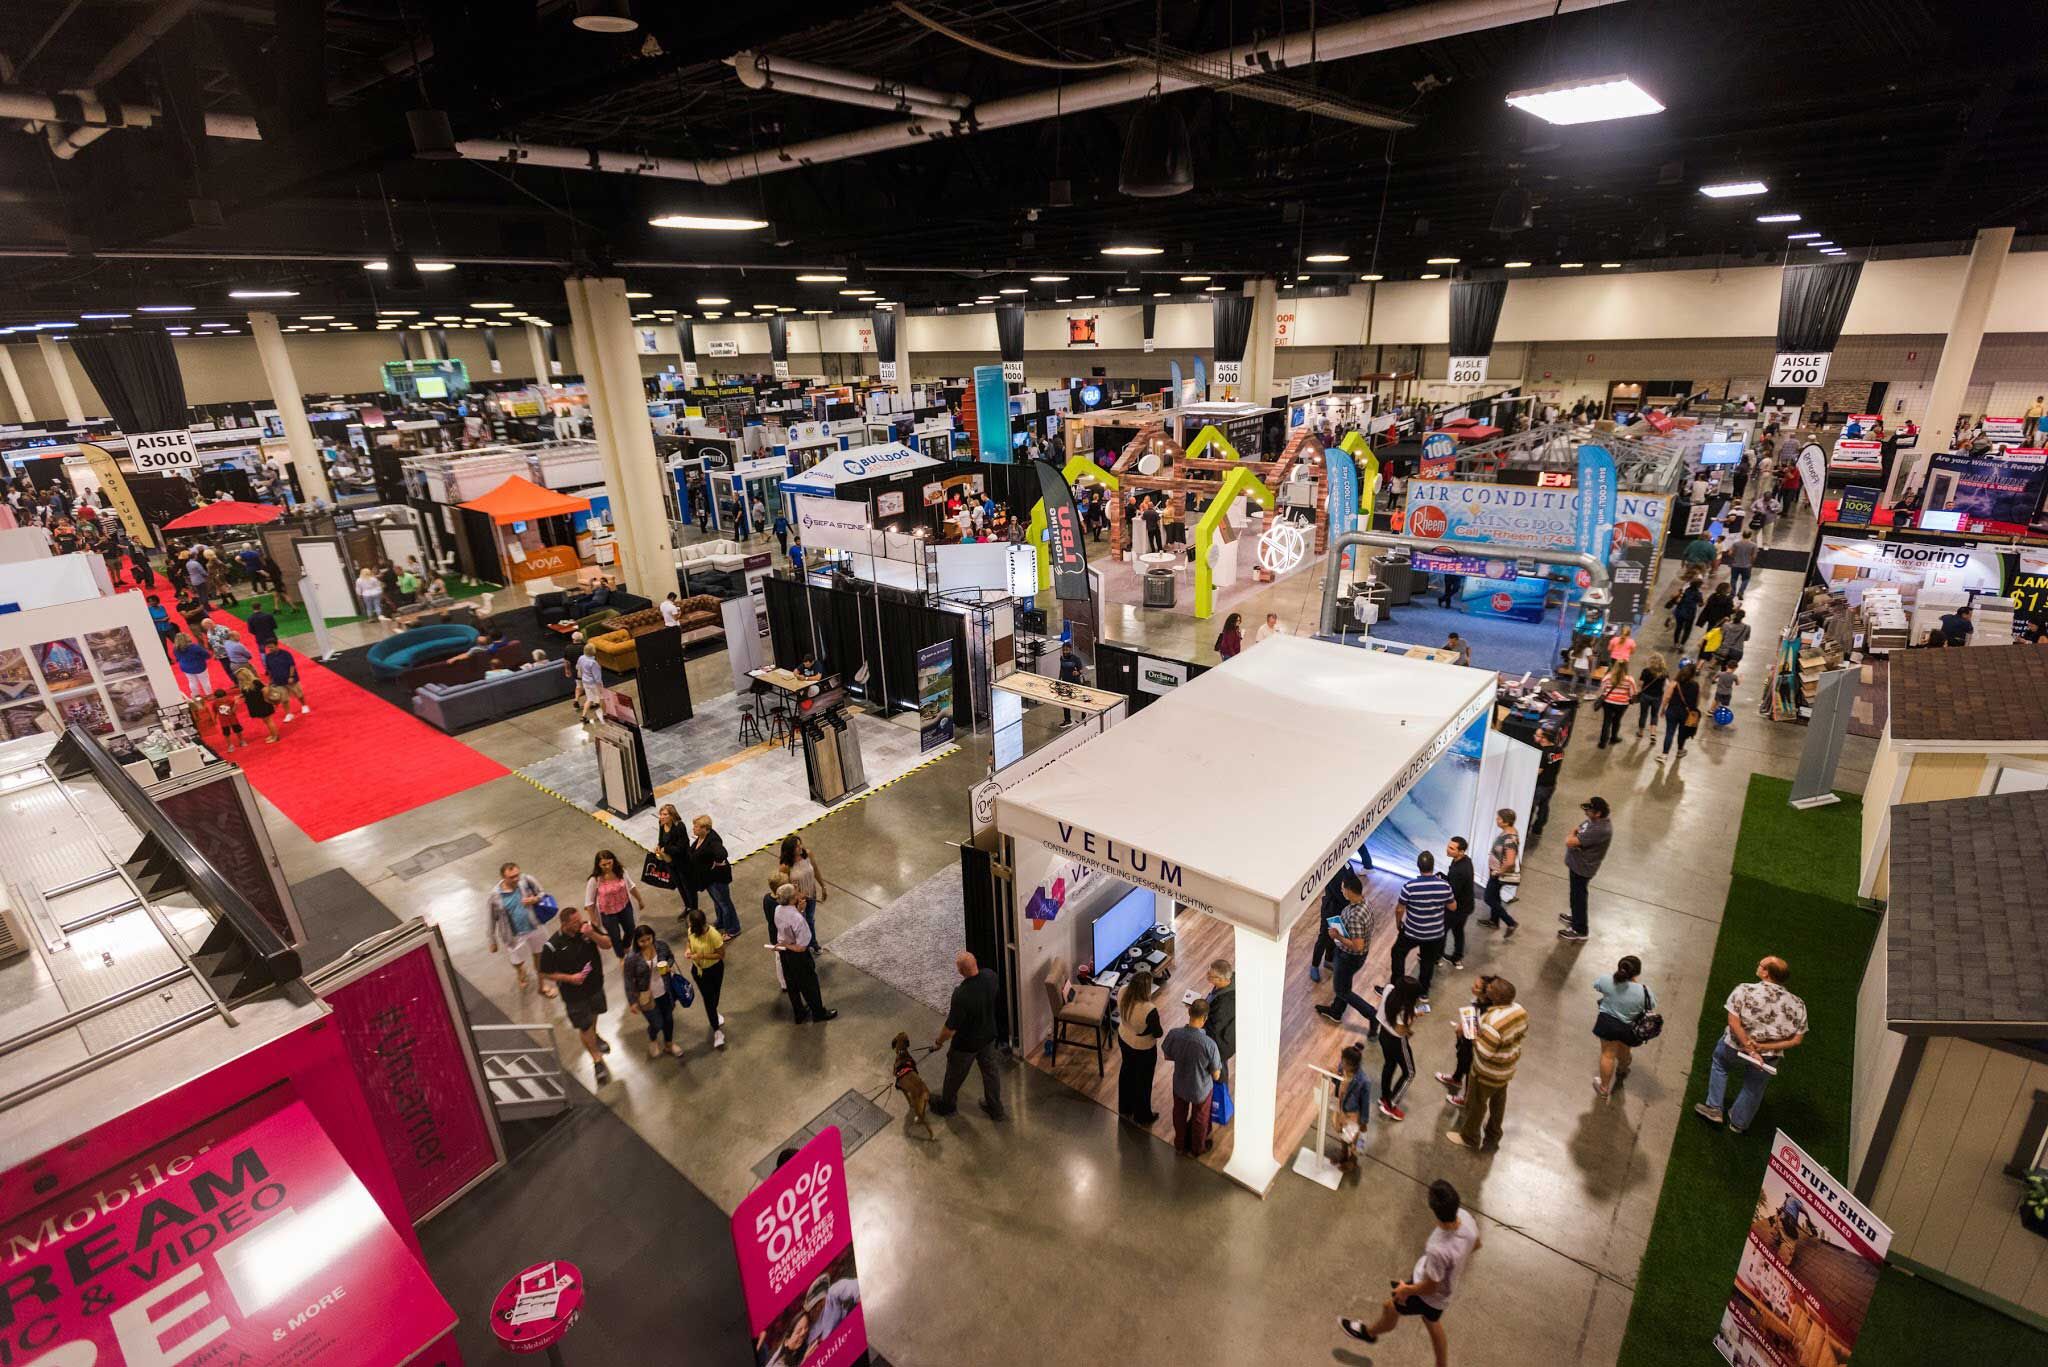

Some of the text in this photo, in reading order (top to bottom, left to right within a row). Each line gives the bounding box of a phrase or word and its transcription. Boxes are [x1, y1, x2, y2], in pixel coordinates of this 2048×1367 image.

[1277, 314, 1294, 322] OOR
[1279, 325, 1286, 334] 3
[1275, 338, 1288, 346] EXIT
[1456, 360, 1482, 368] AISLE
[1782, 357, 1821, 366] AISLE
[882, 370, 895, 378] 1100
[1218, 373, 1238, 383] 900
[1454, 370, 1480, 381] 800
[1780, 369, 1817, 383] 700
[136, 435, 187, 449] AISLE
[140, 450, 192, 468] 3000
[860, 450, 909, 467] BULLDOG
[1972, 460, 2008, 469] Windows
[2010, 463, 2044, 471] Ready?
[104, 472, 118, 492] HOT
[1414, 485, 1449, 501] AIR
[1845, 501, 1872, 512] 100%
[836, 522, 865, 531] STONE
[1413, 506, 1446, 536] Rheem
[1049, 507, 1063, 564] LIGHTING
[1455, 526, 1479, 536] Call
[526, 556, 562, 570] VOYA
[1872, 557, 1952, 569] FACTORY OUTLET
[1881, 543, 1970, 569] Flooring
[2014, 575, 2048, 589] LAM
[1148, 670, 1175, 683] Orchard
[1300, 804, 1377, 902] CONTEMPORARY
[1377, 771, 1408, 814] CEILING
[1409, 740, 1442, 780] DESIGNS
[1449, 697, 1481, 738] LIGHTING
[1058, 821, 1182, 887] VELUM
[1043, 840, 1214, 914] CONTEMPORARY CEILING DESIGNS & LIGHTING
[368, 1004, 446, 1168] #Uncarrier
[755, 1160, 832, 1243] 50%
[1771, 1159, 1852, 1239] DELIVERED & INSTALLED
[1801, 1165, 1879, 1242] TUFF SHED
[766, 1185, 829, 1263] OFF
[81, 1284, 115, 1316] &
[129, 1183, 288, 1282] VIDEO
[768, 1210, 834, 1279] FAMILY LINES
[769, 1219, 835, 1289] FOR MILITARY
[775, 1233, 834, 1295] & VETERANS
[1758, 1241, 1775, 1262] YOUR
[1775, 1257, 1807, 1294] HARDEST
[1806, 1291, 1821, 1311] JOB
[272, 1286, 347, 1342] & MORE
[1735, 1307, 1782, 1365] PERSONALIZING
